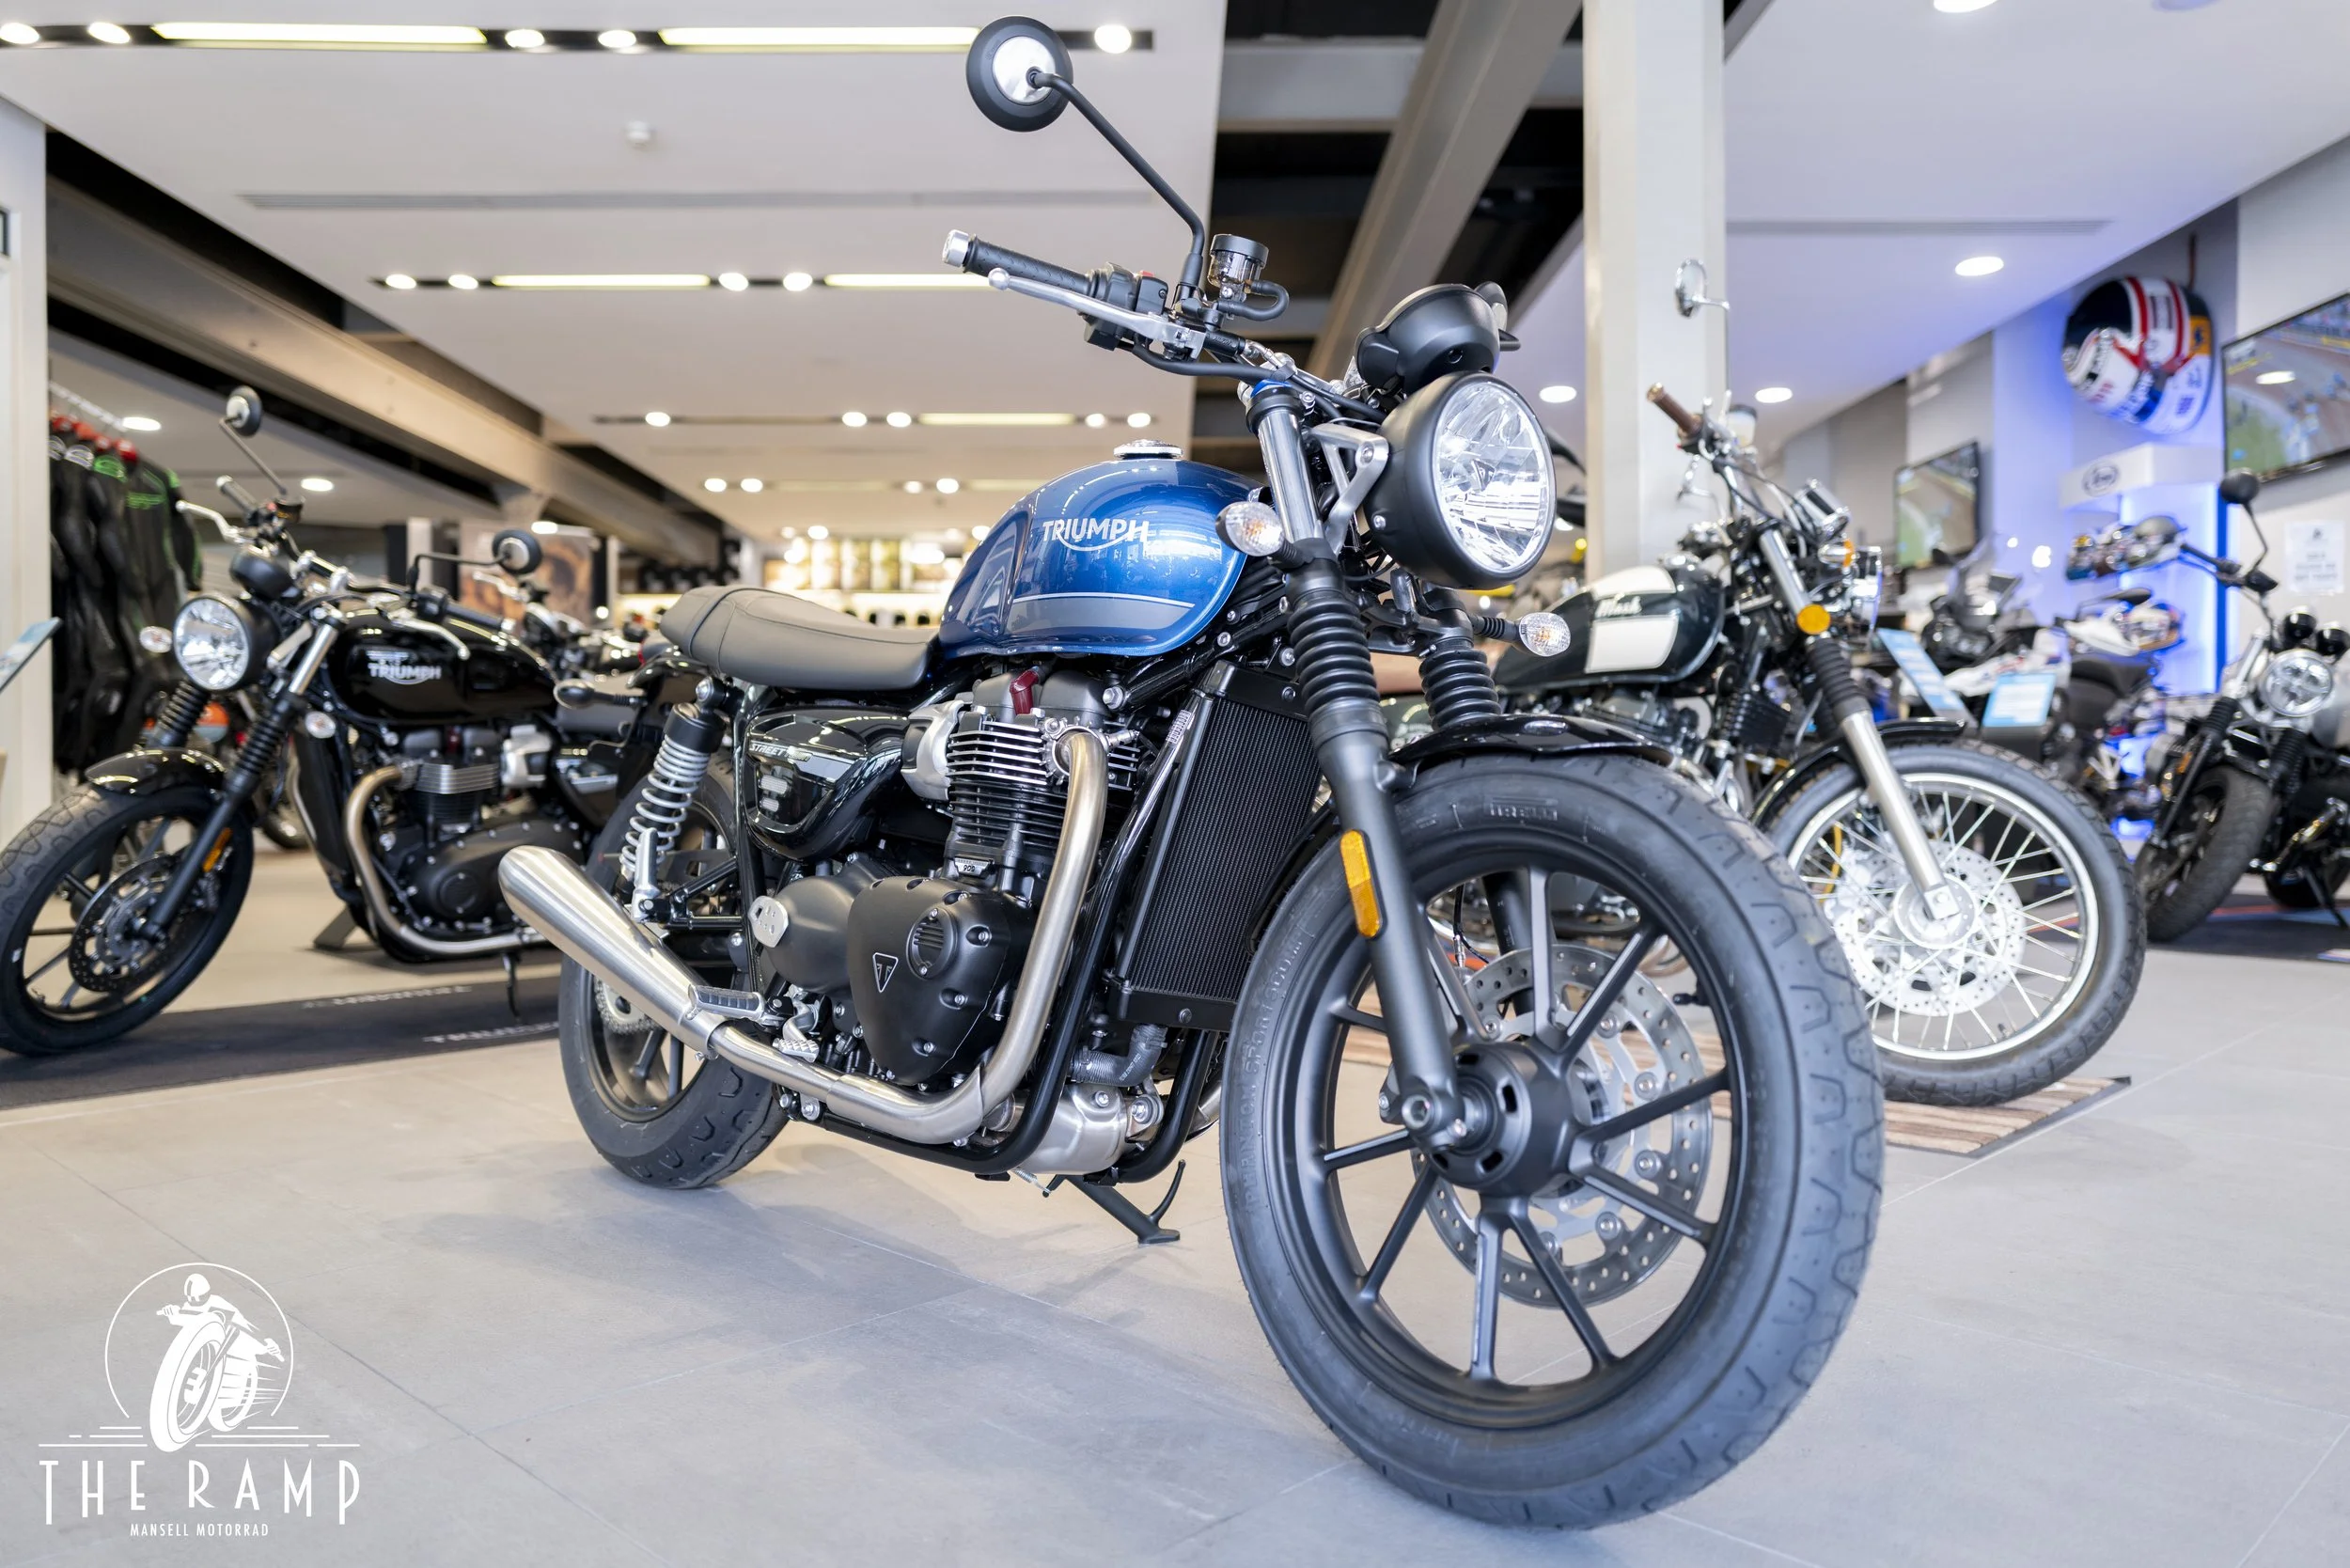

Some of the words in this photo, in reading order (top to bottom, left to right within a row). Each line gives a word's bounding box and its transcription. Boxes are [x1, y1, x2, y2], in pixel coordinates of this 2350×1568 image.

[1042, 518, 1150, 550] TRIUMPH
[368, 662, 442, 682] TRIUMPH
[749, 743, 786, 756] STREET
[1239, 1084, 1261, 1208] PHANTOM
